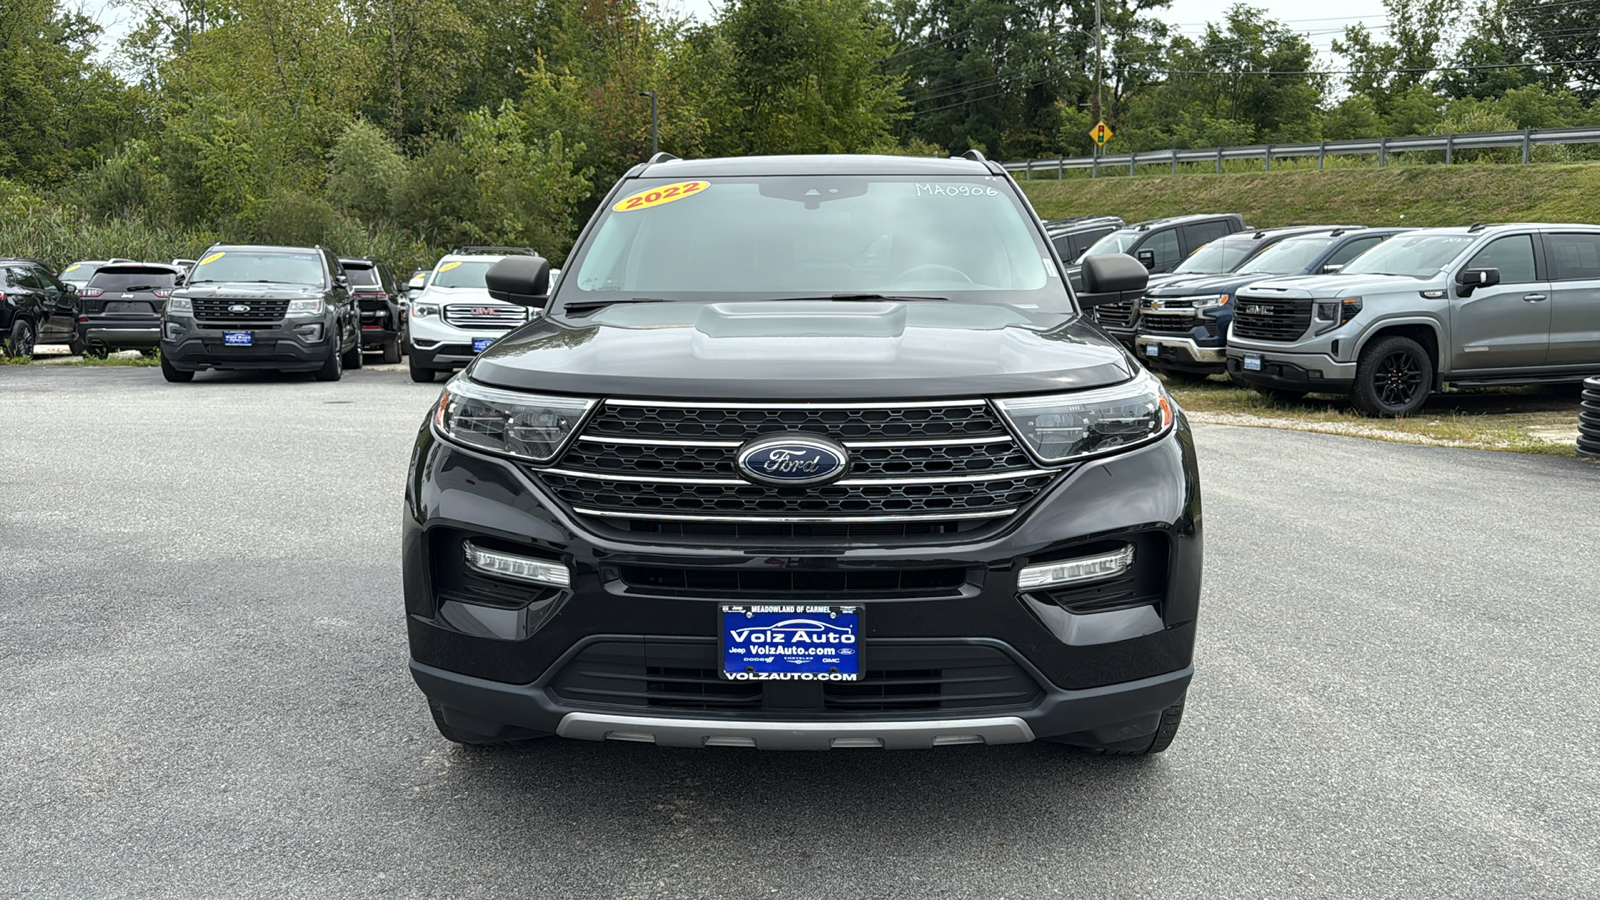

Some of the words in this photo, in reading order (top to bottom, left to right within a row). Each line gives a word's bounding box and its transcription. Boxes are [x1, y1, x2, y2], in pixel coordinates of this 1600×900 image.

[625, 182, 700, 210] 2022
[471, 307, 502, 316] GMC
[763, 449, 820, 473] Ford
[751, 605, 795, 613] MEADOWLAND
[796, 605, 805, 613] OF
[805, 605, 832, 613] CARMEL
[730, 630, 785, 643] Volz
[791, 630, 856, 644] Auto
[750, 645, 836, 655] VolzAuto.com
[725, 672, 858, 681] VOLZAUTO.COM
